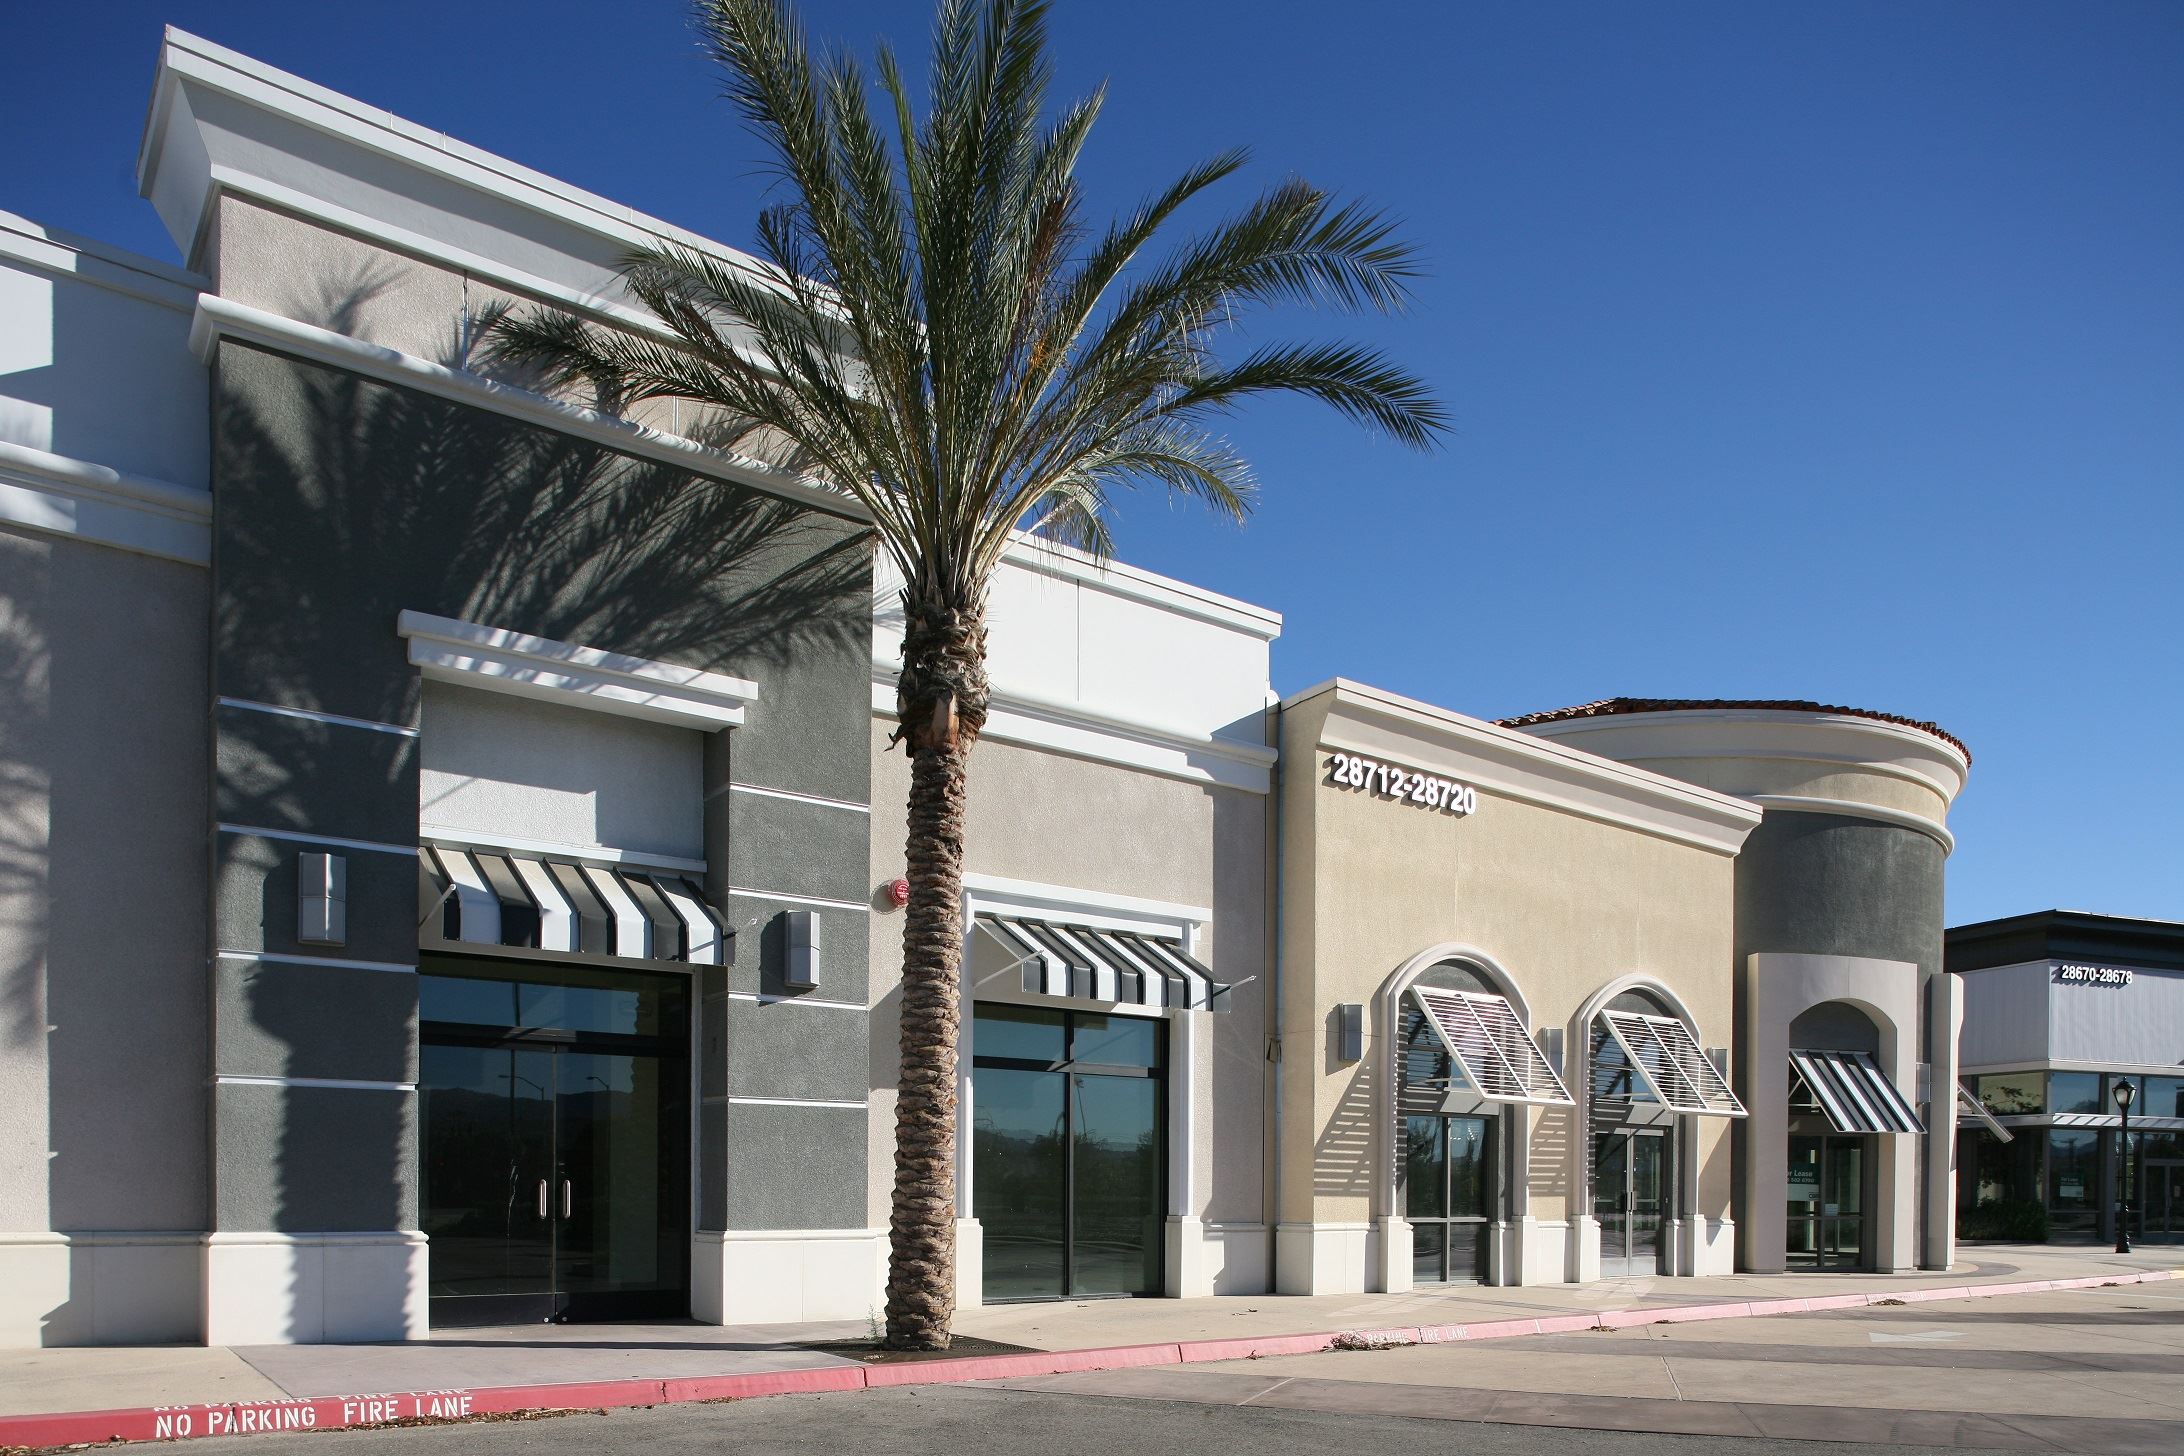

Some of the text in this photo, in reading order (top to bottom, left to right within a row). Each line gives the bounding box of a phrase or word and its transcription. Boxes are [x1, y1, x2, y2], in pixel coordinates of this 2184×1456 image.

[1334, 753, 1477, 815] 28712-28720
[2062, 965, 2133, 984] 28670-28678
[155, 1396, 473, 1438] NO PARKING FIRE LANE
